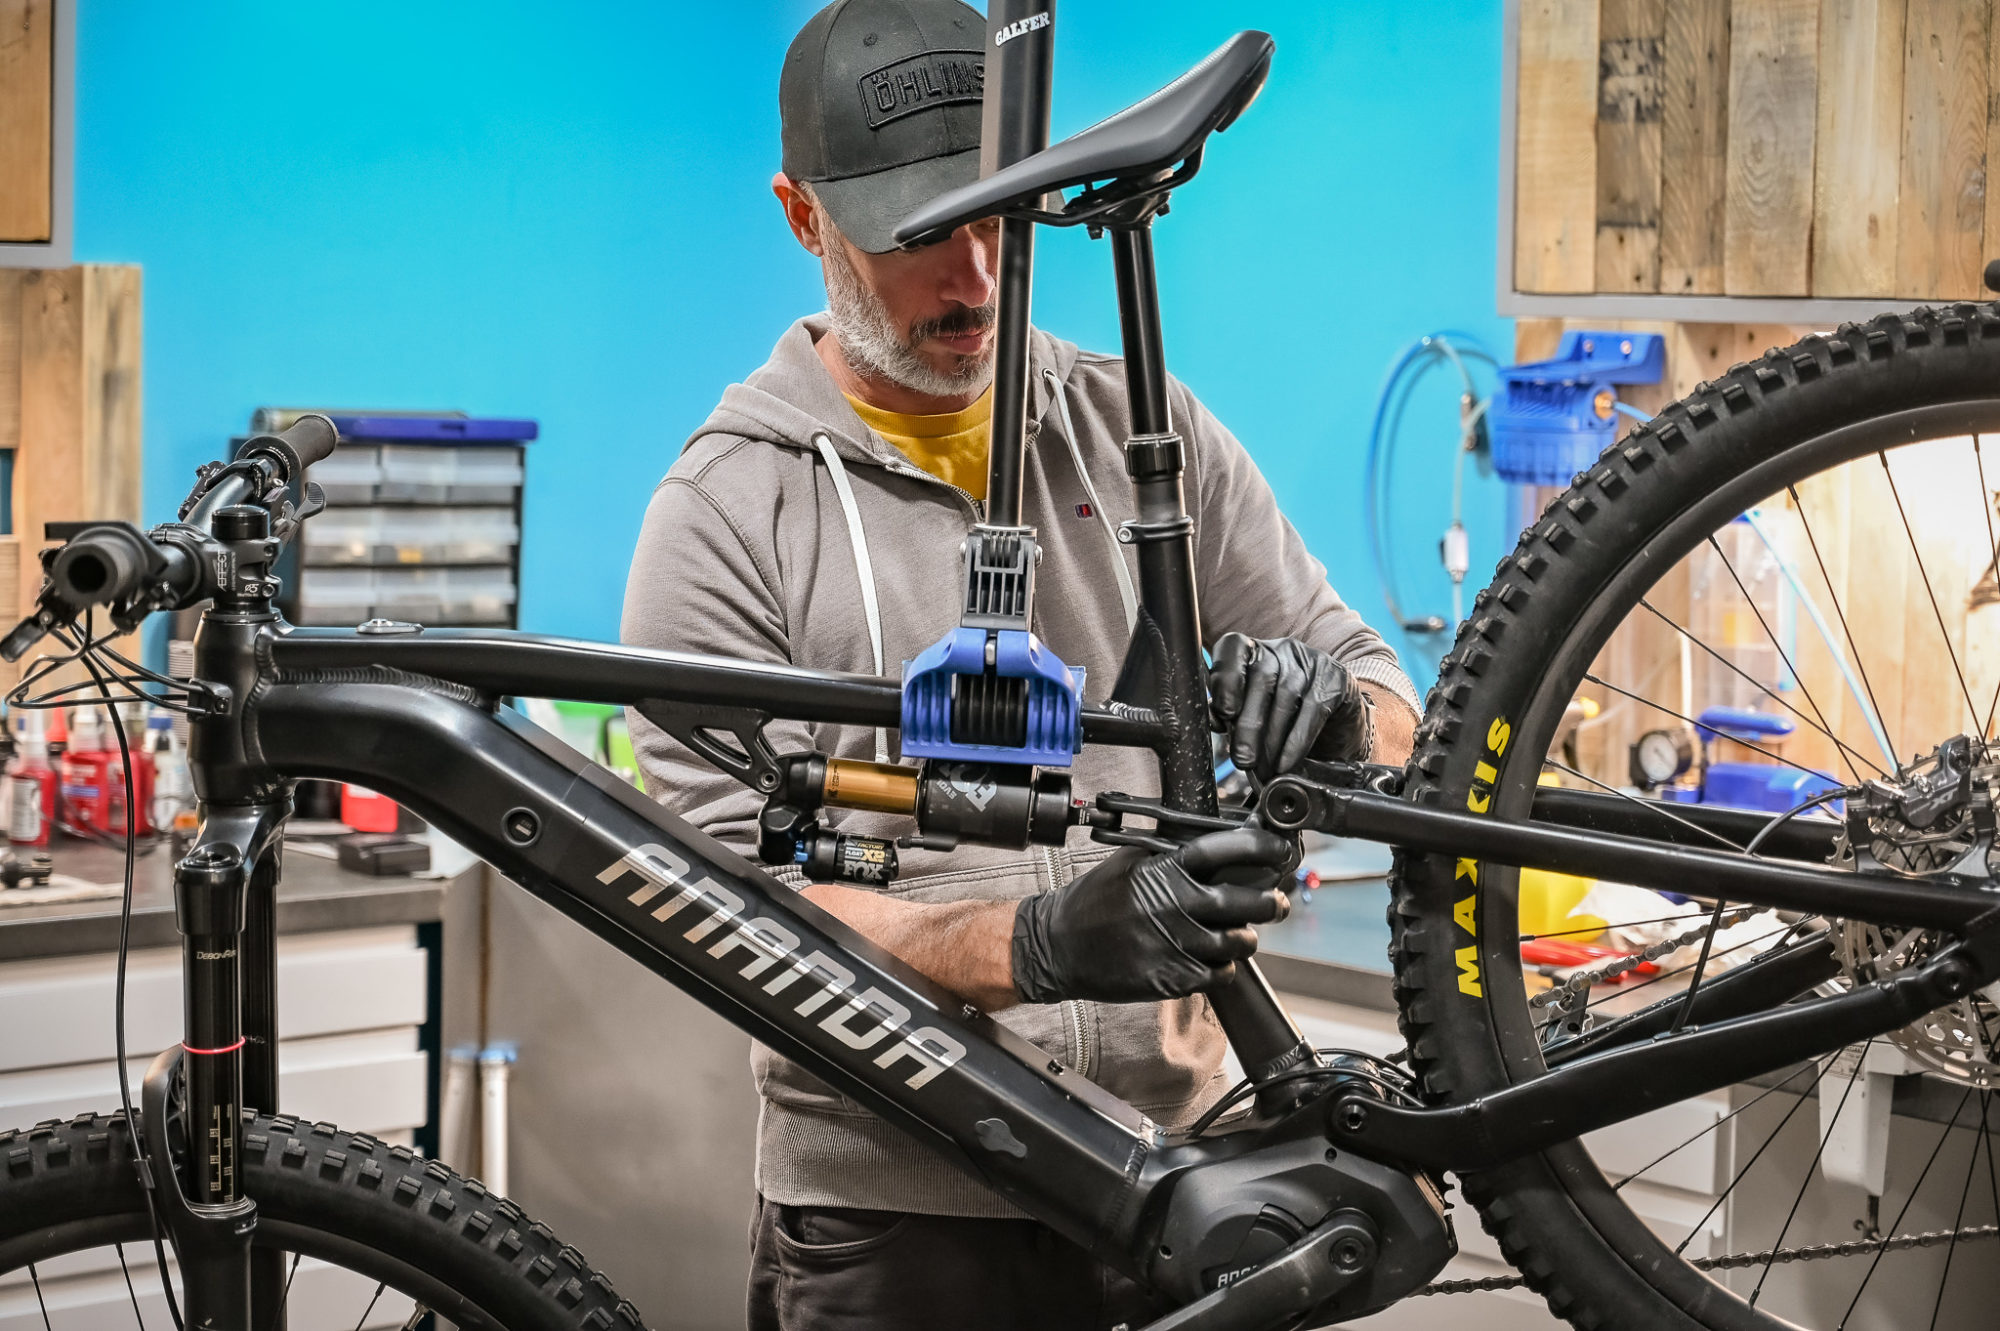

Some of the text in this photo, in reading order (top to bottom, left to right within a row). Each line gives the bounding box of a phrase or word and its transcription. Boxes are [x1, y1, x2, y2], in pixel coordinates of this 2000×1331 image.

[995, 11, 1051, 47] GALFER
[860, 848, 886, 863] X2
[842, 860, 884, 881] FOX
[595, 843, 967, 1091] ANANDA
